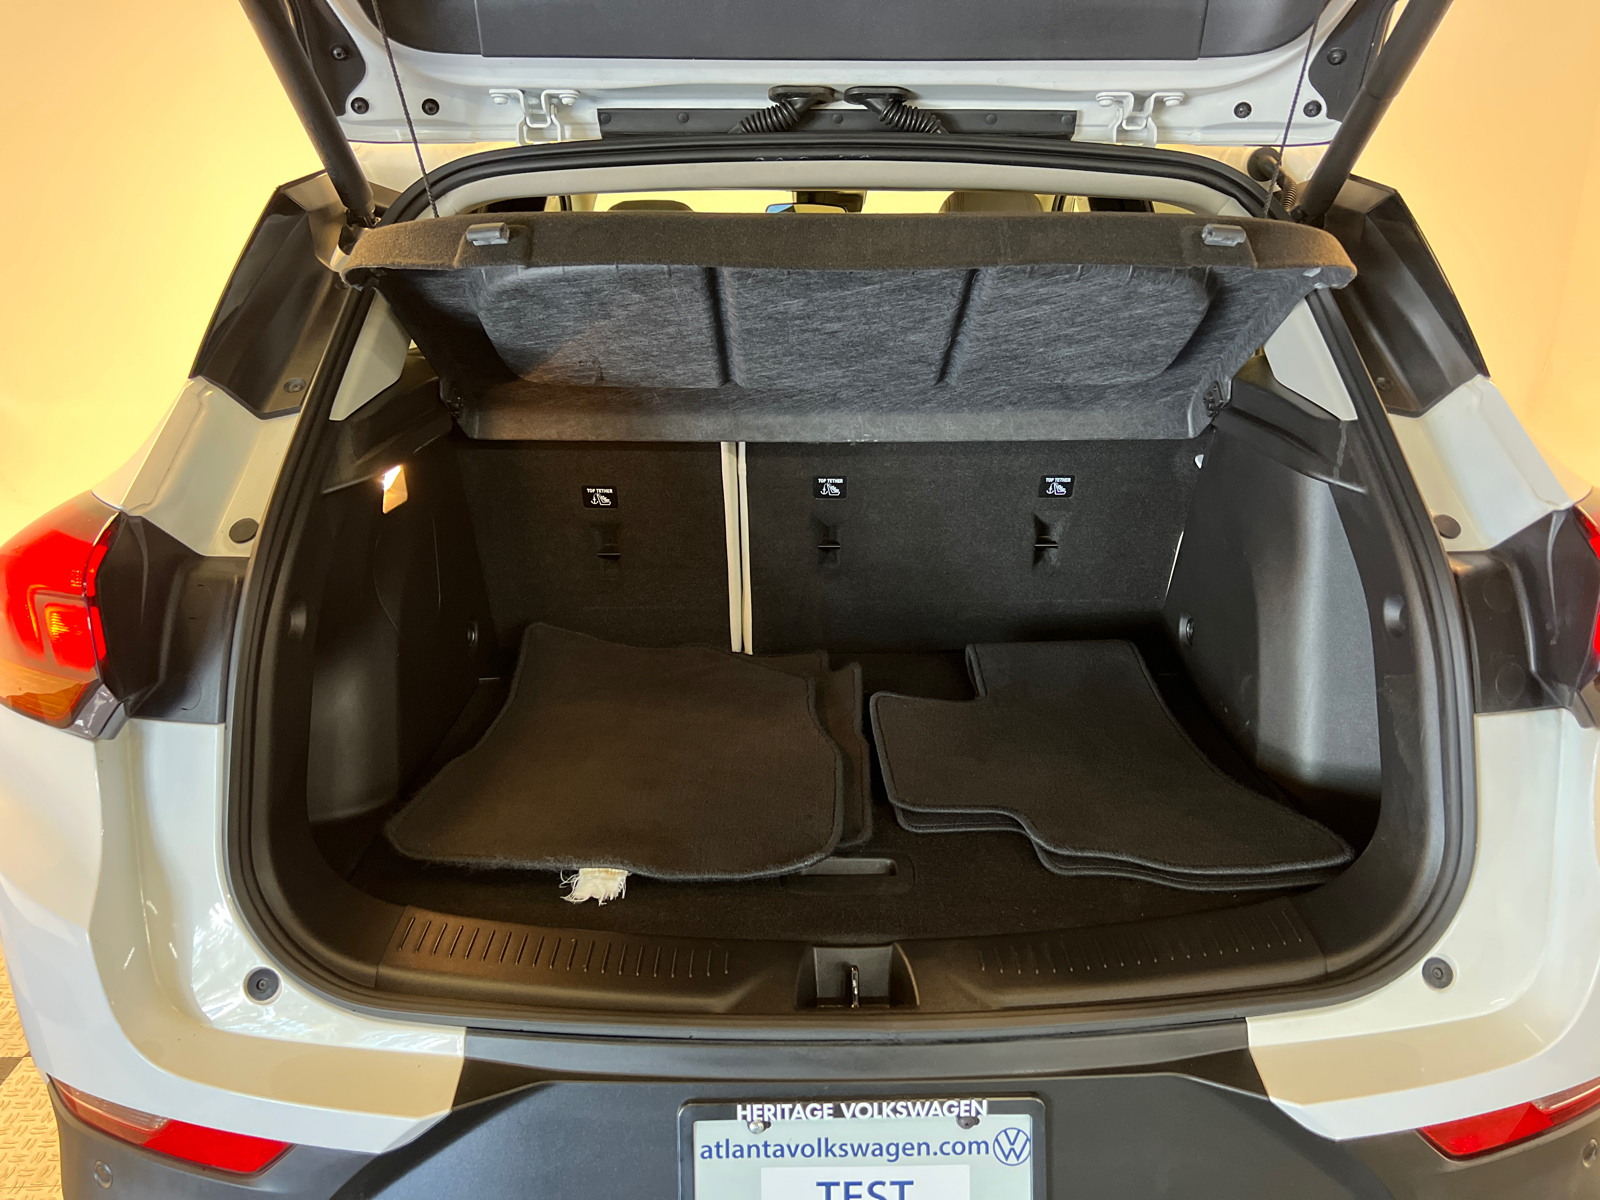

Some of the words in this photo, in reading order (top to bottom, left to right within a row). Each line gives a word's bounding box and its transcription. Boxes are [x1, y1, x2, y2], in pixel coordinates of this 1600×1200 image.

[736, 1104, 834, 1121] HERITAGE
[840, 1100, 988, 1118] VOLKSWAGEN
[700, 1138, 990, 1163] atlantavolkswagen.com
[815, 1180, 914, 1200] TEST
